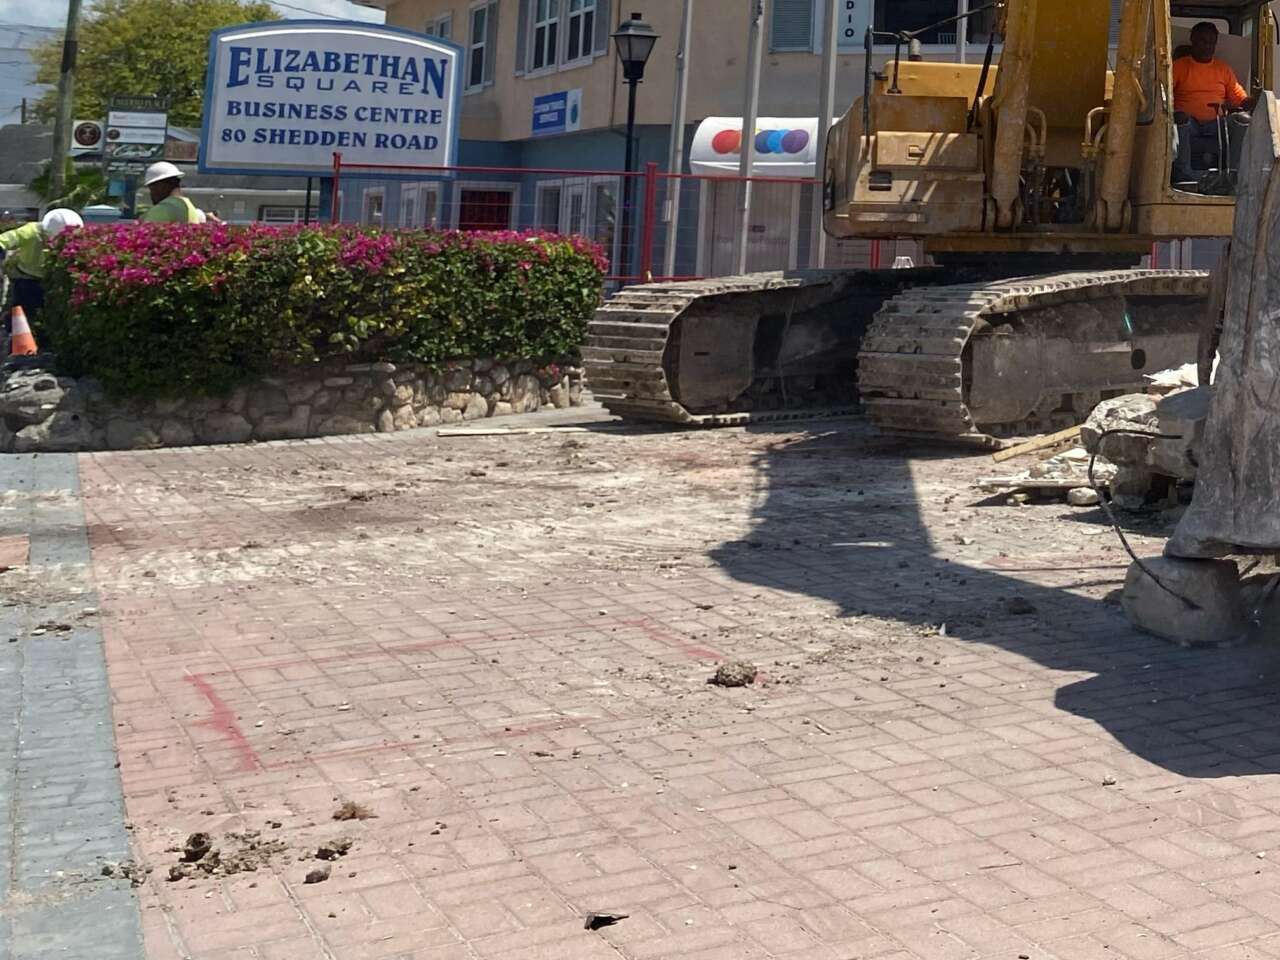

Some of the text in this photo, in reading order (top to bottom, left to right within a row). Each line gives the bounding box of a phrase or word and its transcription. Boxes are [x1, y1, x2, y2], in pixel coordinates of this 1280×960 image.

[226, 46, 448, 100] ELIZABETHAN
[256, 75, 415, 96] SQUARE
[226, 100, 442, 125] BUSINESS CENTRE
[221, 128, 438, 150] 80 SHEDDEN ROAD
